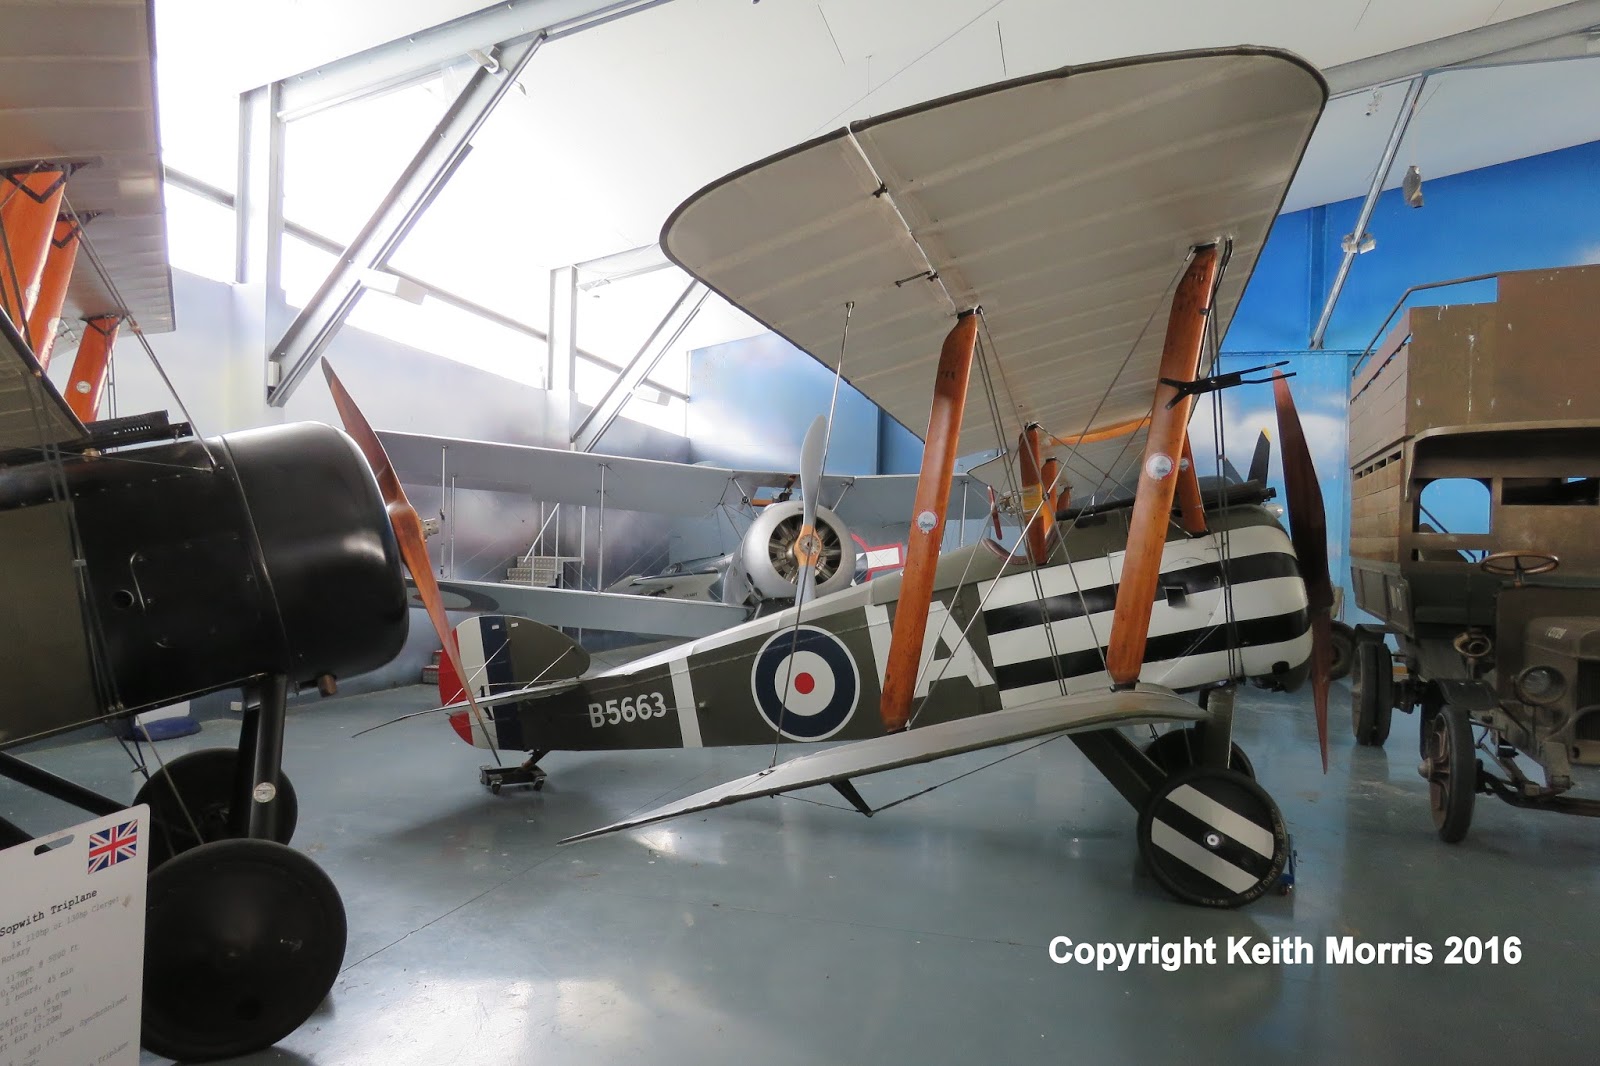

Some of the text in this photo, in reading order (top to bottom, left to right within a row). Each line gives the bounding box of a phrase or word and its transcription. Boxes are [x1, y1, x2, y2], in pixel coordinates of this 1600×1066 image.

[912, 600, 996, 699] A
[588, 692, 667, 728] B5663
[0, 890, 97, 937] Sopwith Triplane
[1, 946, 31, 964] Rotary
